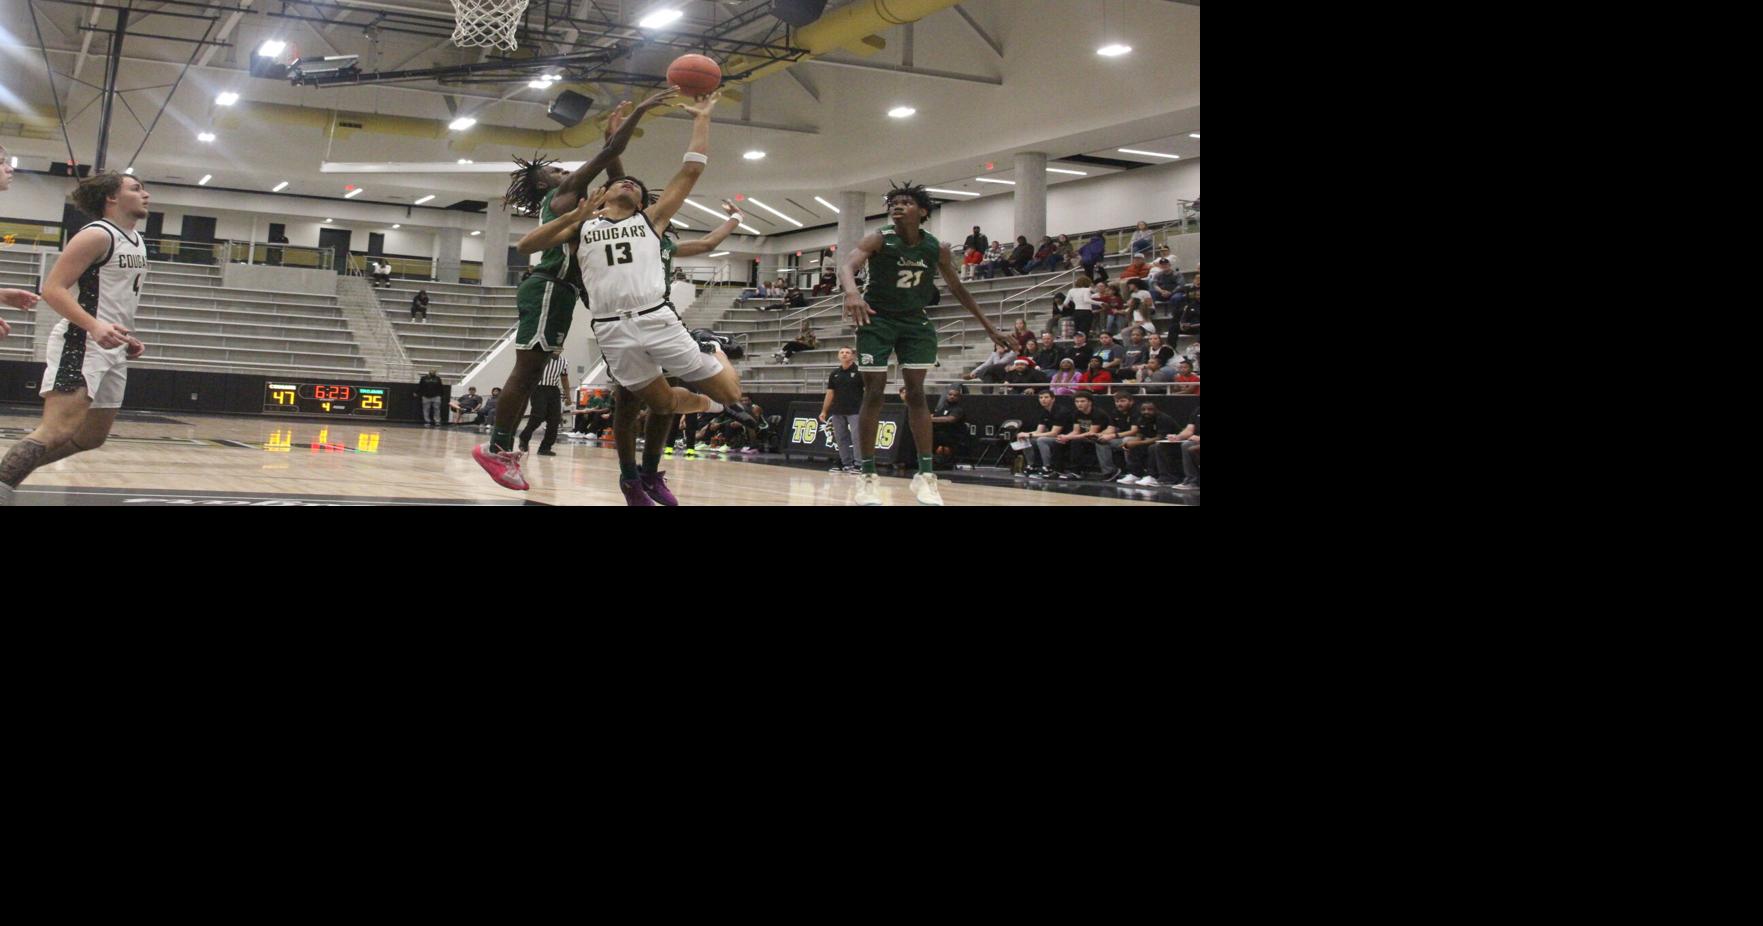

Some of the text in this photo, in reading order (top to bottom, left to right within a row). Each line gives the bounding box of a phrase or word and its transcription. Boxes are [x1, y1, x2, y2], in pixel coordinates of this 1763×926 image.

[584, 225, 646, 244] COUGARS
[605, 242, 633, 267] 13
[896, 269, 924, 288] 21
[273, 391, 296, 405] 47
[315, 385, 350, 400] 6:23
[322, 402, 331, 412] 4
[361, 395, 383, 409] 25
[792, 417, 818, 444] TC
